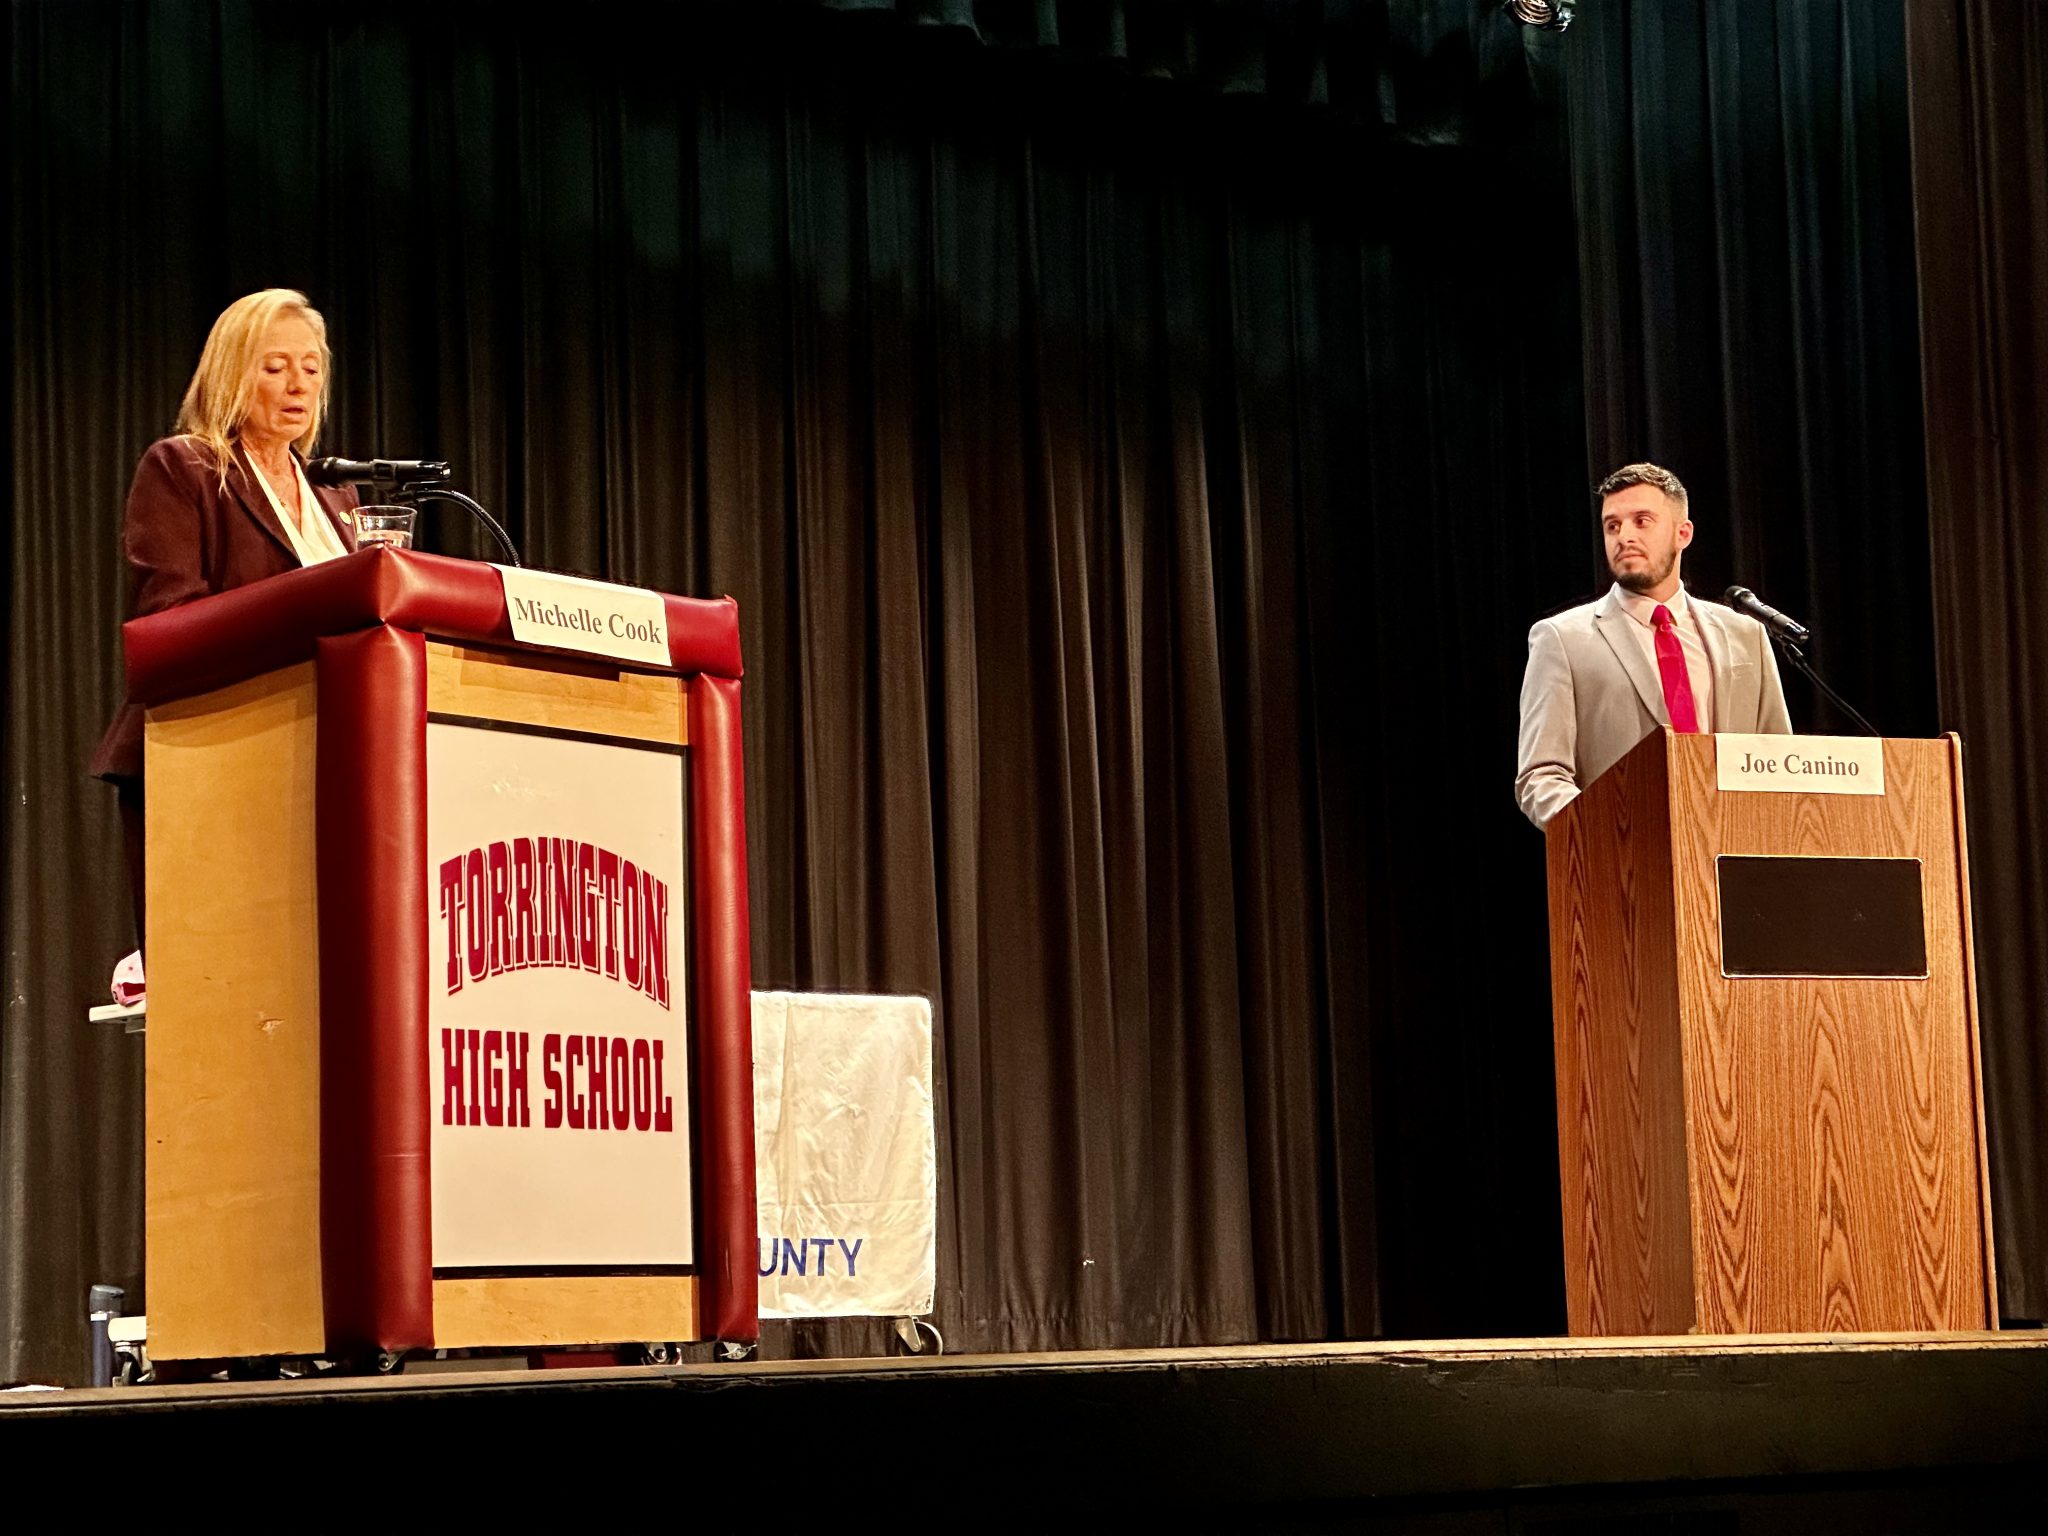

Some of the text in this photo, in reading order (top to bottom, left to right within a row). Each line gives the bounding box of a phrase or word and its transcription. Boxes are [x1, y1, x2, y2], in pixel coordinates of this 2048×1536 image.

[512, 597, 662, 645] Michelle Cook
[1741, 753, 1860, 776] Joe Canino
[440, 837, 670, 1011] TORRINGTON
[442, 1028, 673, 1132] HIGH SCHOOL
[757, 1237, 863, 1277] UNTY
